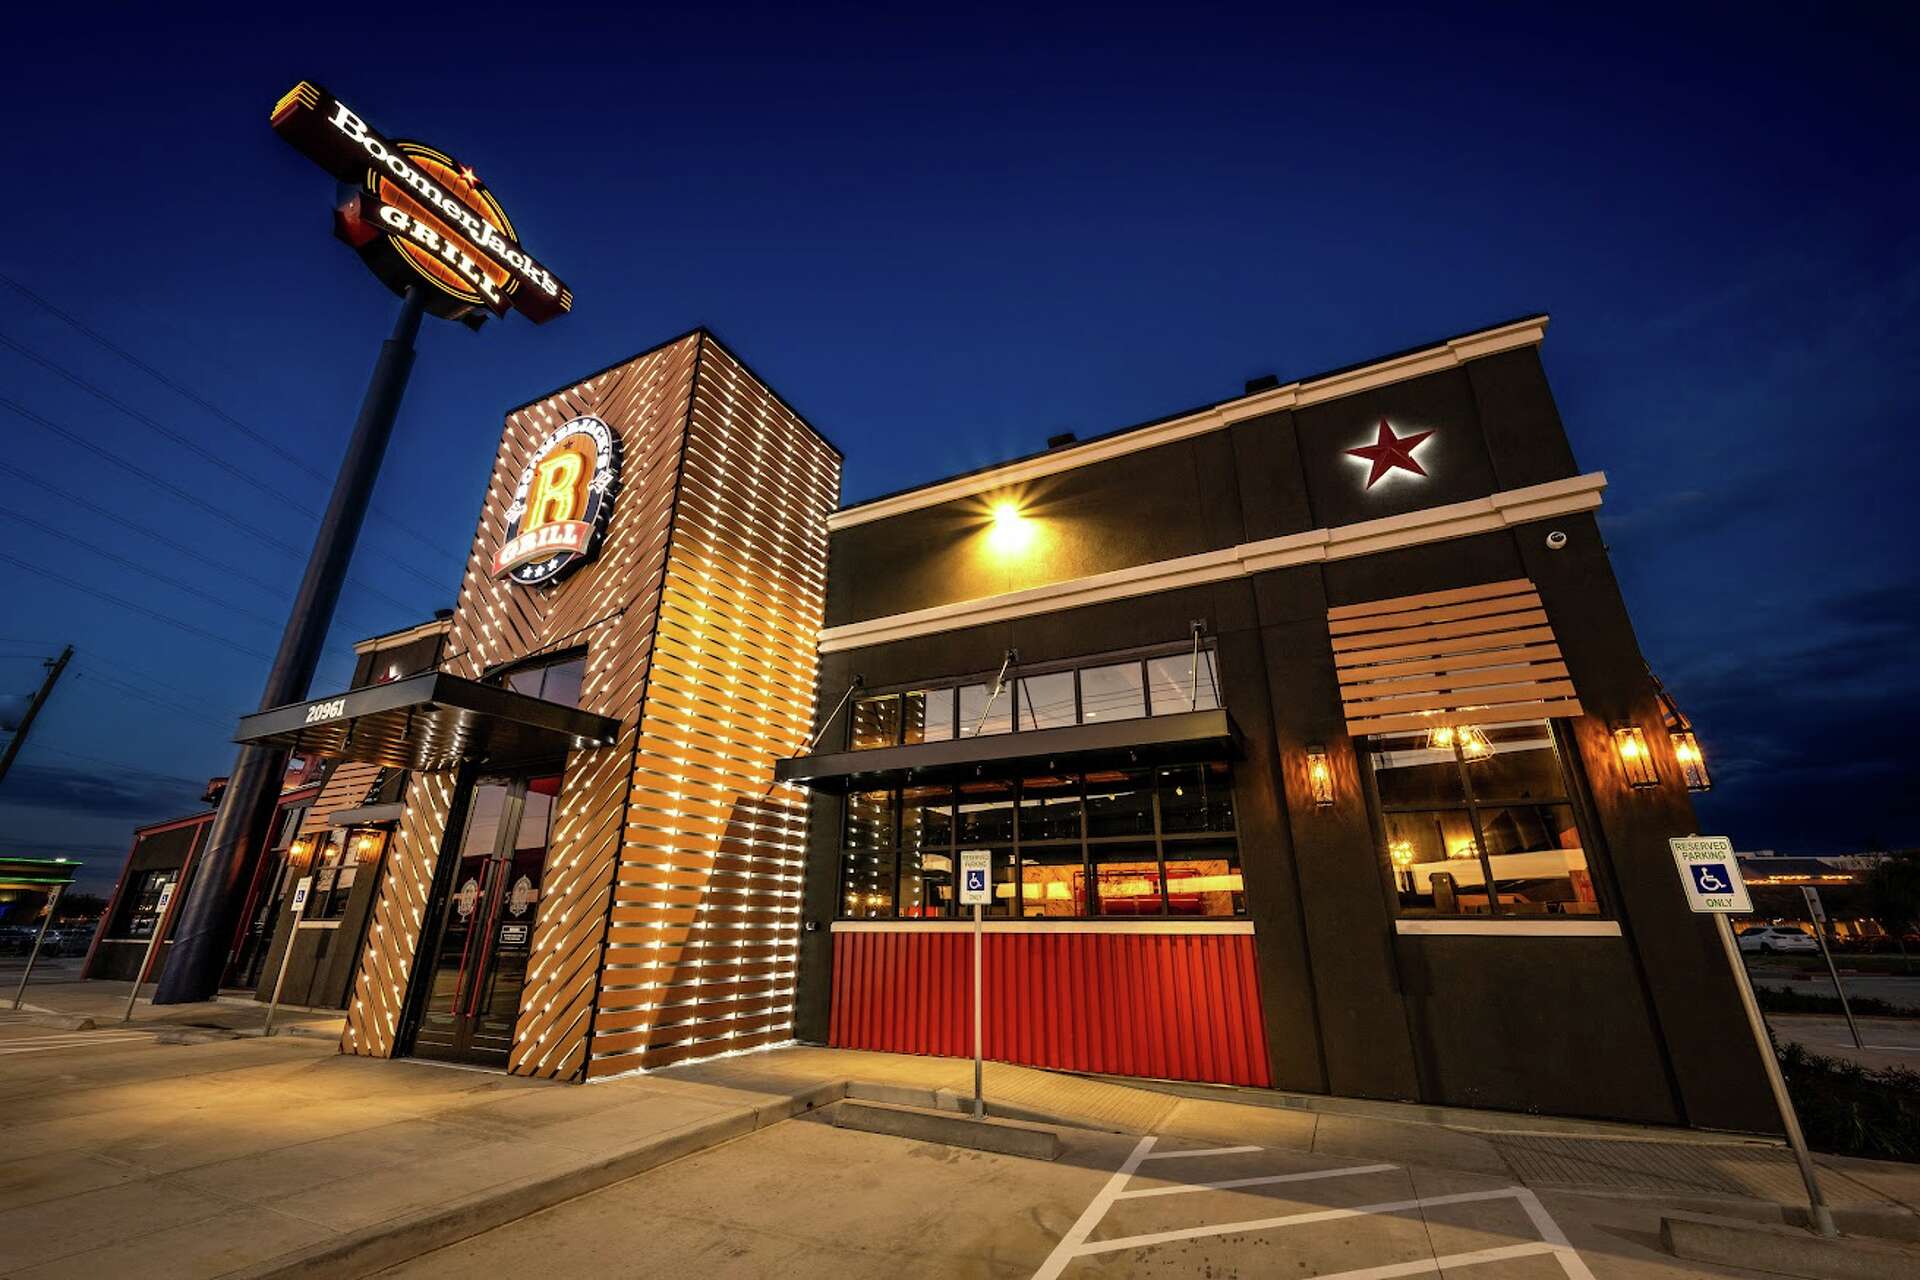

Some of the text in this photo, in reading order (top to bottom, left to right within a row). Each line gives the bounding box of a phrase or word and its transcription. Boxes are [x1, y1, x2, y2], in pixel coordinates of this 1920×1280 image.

[328, 100, 558, 297] BoomerJack's
[379, 205, 500, 304] GRILL
[499, 523, 577, 565] GRILL
[305, 698, 346, 723] 20961
[1674, 841, 1728, 851] RESERVED
[1682, 850, 1726, 861] PARKING
[1705, 898, 1732, 908] ONLY
